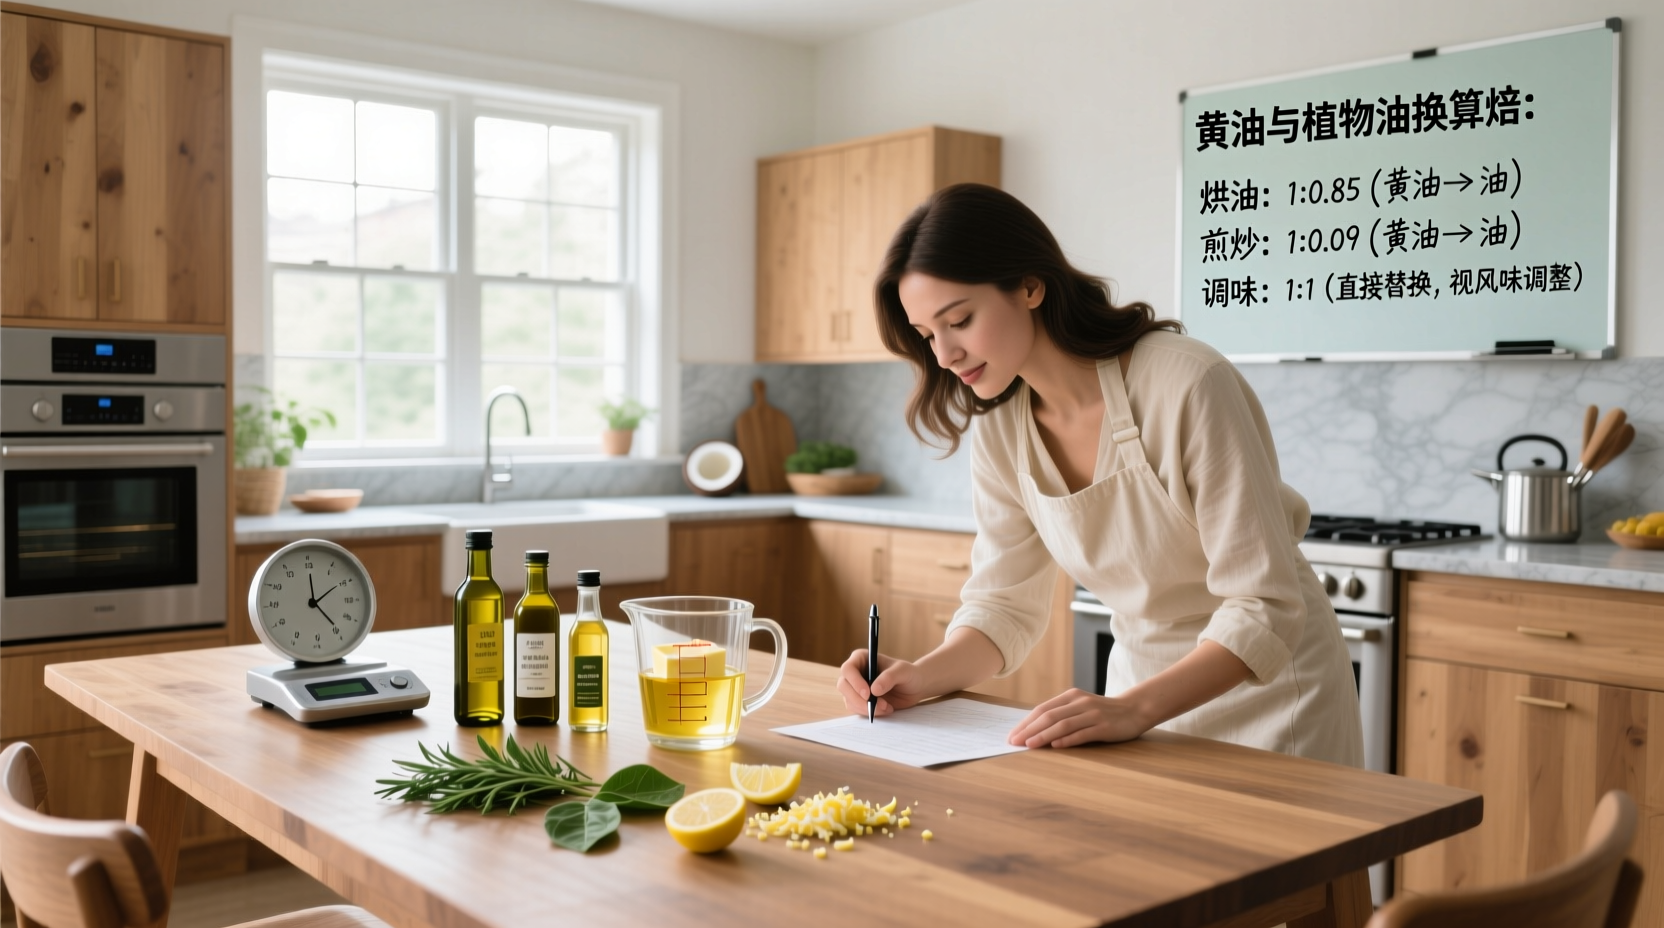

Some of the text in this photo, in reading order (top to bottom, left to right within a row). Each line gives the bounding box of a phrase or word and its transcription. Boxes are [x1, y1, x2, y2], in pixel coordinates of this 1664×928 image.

[1195, 84, 1535, 153] 黄油与植物油换算焙：
[1287, 175, 1362, 206] 1:0.85
[1286, 224, 1361, 255] 1:0.09
